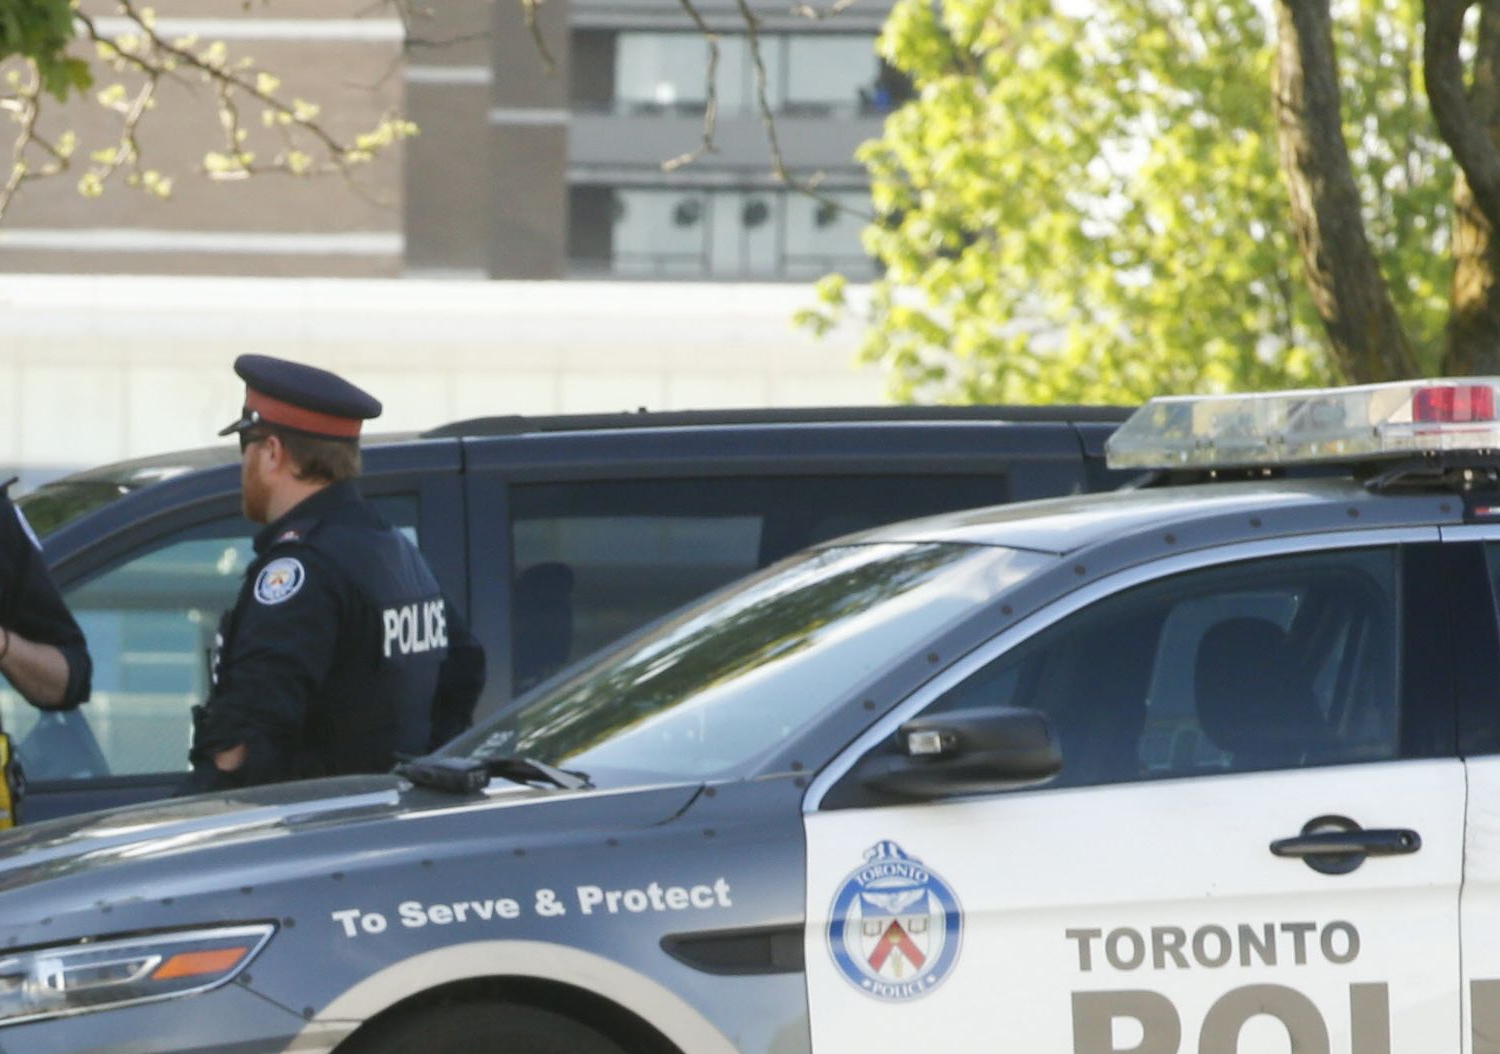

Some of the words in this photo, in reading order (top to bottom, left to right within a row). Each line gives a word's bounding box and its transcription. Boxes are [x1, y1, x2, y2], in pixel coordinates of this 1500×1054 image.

[383, 598, 448, 658] POLICE
[332, 909, 387, 938] To
[398, 893, 521, 929] Serve
[535, 888, 566, 917] &
[577, 878, 732, 915] Protect
[1065, 920, 1361, 972] TORONTO
